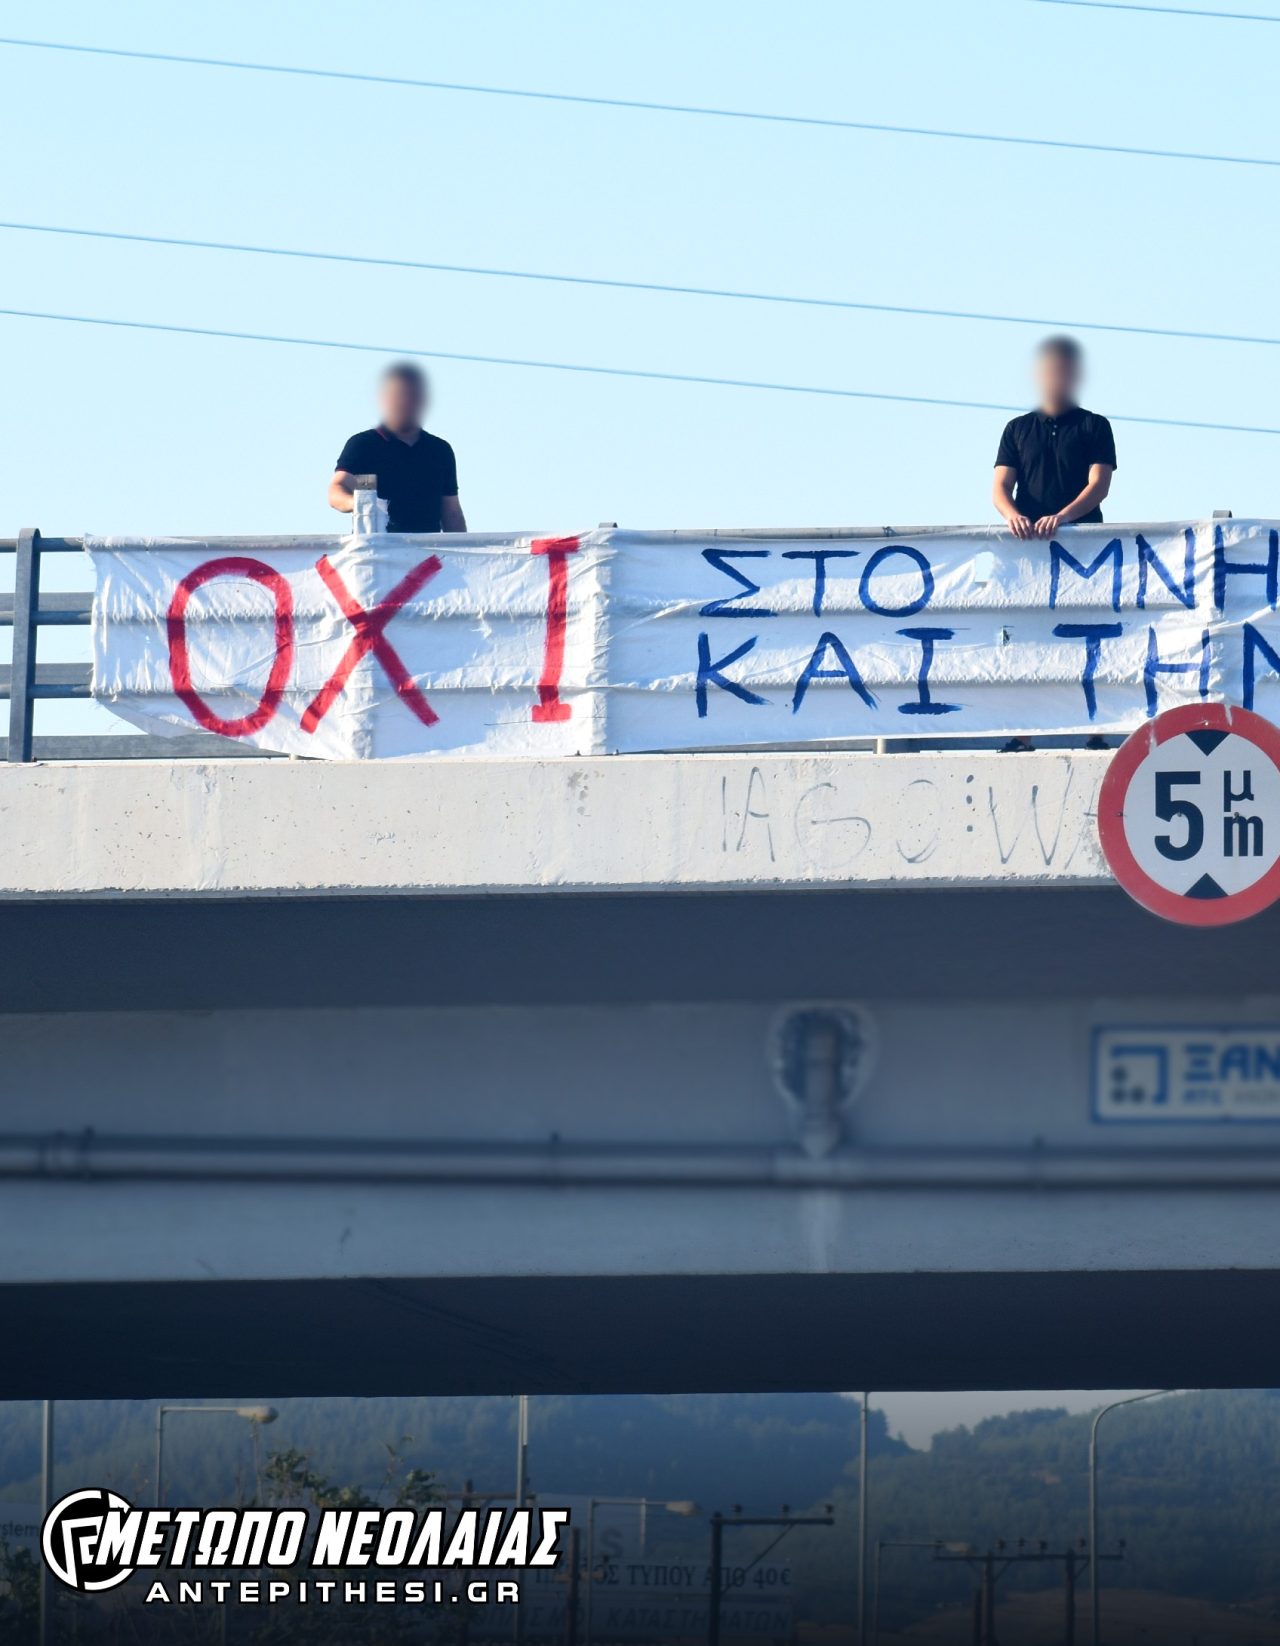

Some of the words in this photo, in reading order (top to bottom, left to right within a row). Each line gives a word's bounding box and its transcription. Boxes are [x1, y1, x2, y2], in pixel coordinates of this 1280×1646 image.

[699, 545, 935, 618] ΣΤΟ
[167, 536, 581, 737] ΟΧΙ
[695, 627, 962, 718] ΚΑΙ
[1154, 771, 1204, 861] 5
[1223, 815, 1264, 857] m
[753, 1568, 792, 1590] 40€
